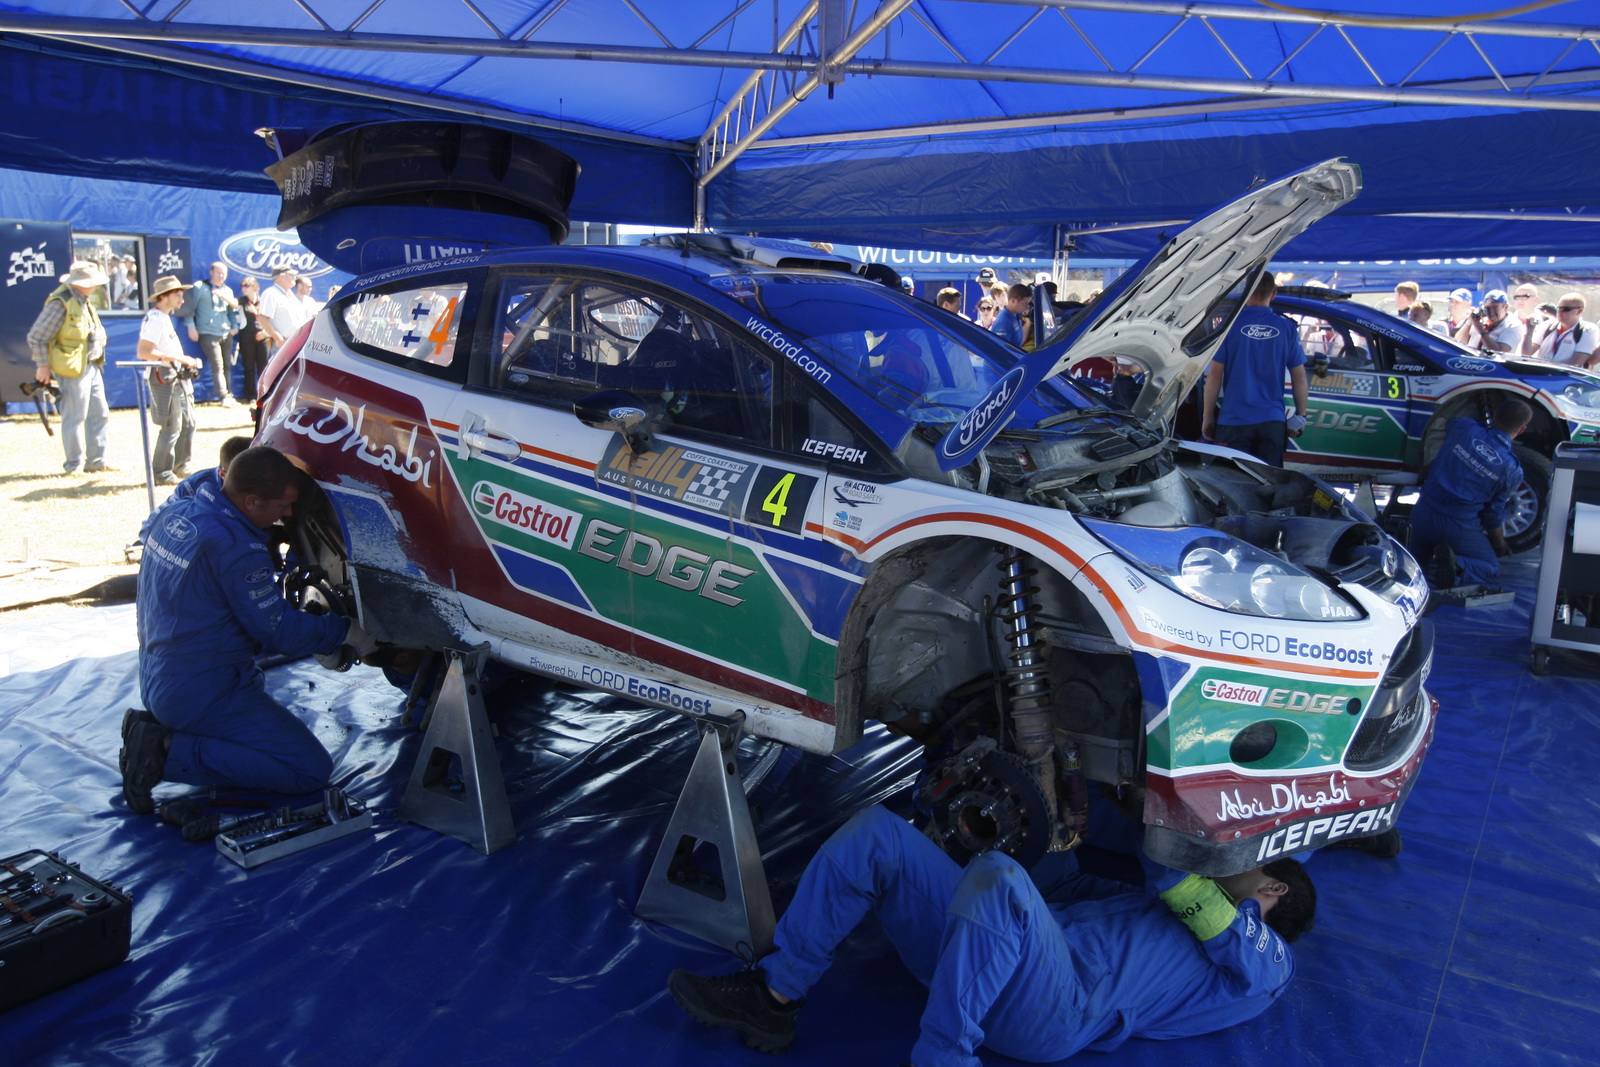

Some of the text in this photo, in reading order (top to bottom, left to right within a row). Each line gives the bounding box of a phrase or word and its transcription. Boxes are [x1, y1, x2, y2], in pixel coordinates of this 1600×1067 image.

[246, 236, 318, 270] Ford
[31, 263, 47, 274] M
[355, 254, 483, 288] Ford recommends Castrol
[427, 297, 458, 355] 4
[1247, 327, 1272, 338] Ford
[1356, 317, 1404, 342] wrcford.com
[746, 316, 832, 385] wrcford.com
[1392, 363, 1425, 372] ICEPEAK
[1454, 357, 1486, 371] Ford
[1309, 385, 1345, 393] AUSTRALIA
[1310, 373, 1355, 394] rally
[1387, 376, 1399, 399] 3
[960, 380, 1011, 445] Ford
[1305, 408, 1383, 433] EDGE
[310, 397, 435, 488] Dhabi
[801, 438, 867, 464] ICEPEAK
[1476, 444, 1497, 462] Ford
[685, 451, 706, 464] COFFS
[706, 457, 727, 469] COAST
[1454, 444, 1471, 459] FORD
[1469, 457, 1482, 469] ABU
[608, 444, 703, 499] rally
[762, 473, 796, 527] 4
[848, 490, 862, 498] ROAD
[862, 492, 883, 503] SAFETY
[851, 482, 877, 494] ACTION
[708, 499, 720, 508] 2011
[166, 518, 190, 539] Ford
[495, 491, 573, 543] Castrol
[155, 545, 168, 559] ABU
[577, 518, 758, 608] EDGE
[251, 569, 268, 581] Ford
[1320, 605, 1355, 617] PIAA
[1143, 612, 1373, 666] Powered by FORD EcoBoost
[530, 657, 711, 715] Powered by FORD EcoBoost
[1216, 682, 1350, 716] Castrol EDGE
[1217, 773, 1352, 822] Abu Dhabi
[1256, 803, 1396, 862] ICEPEAK
